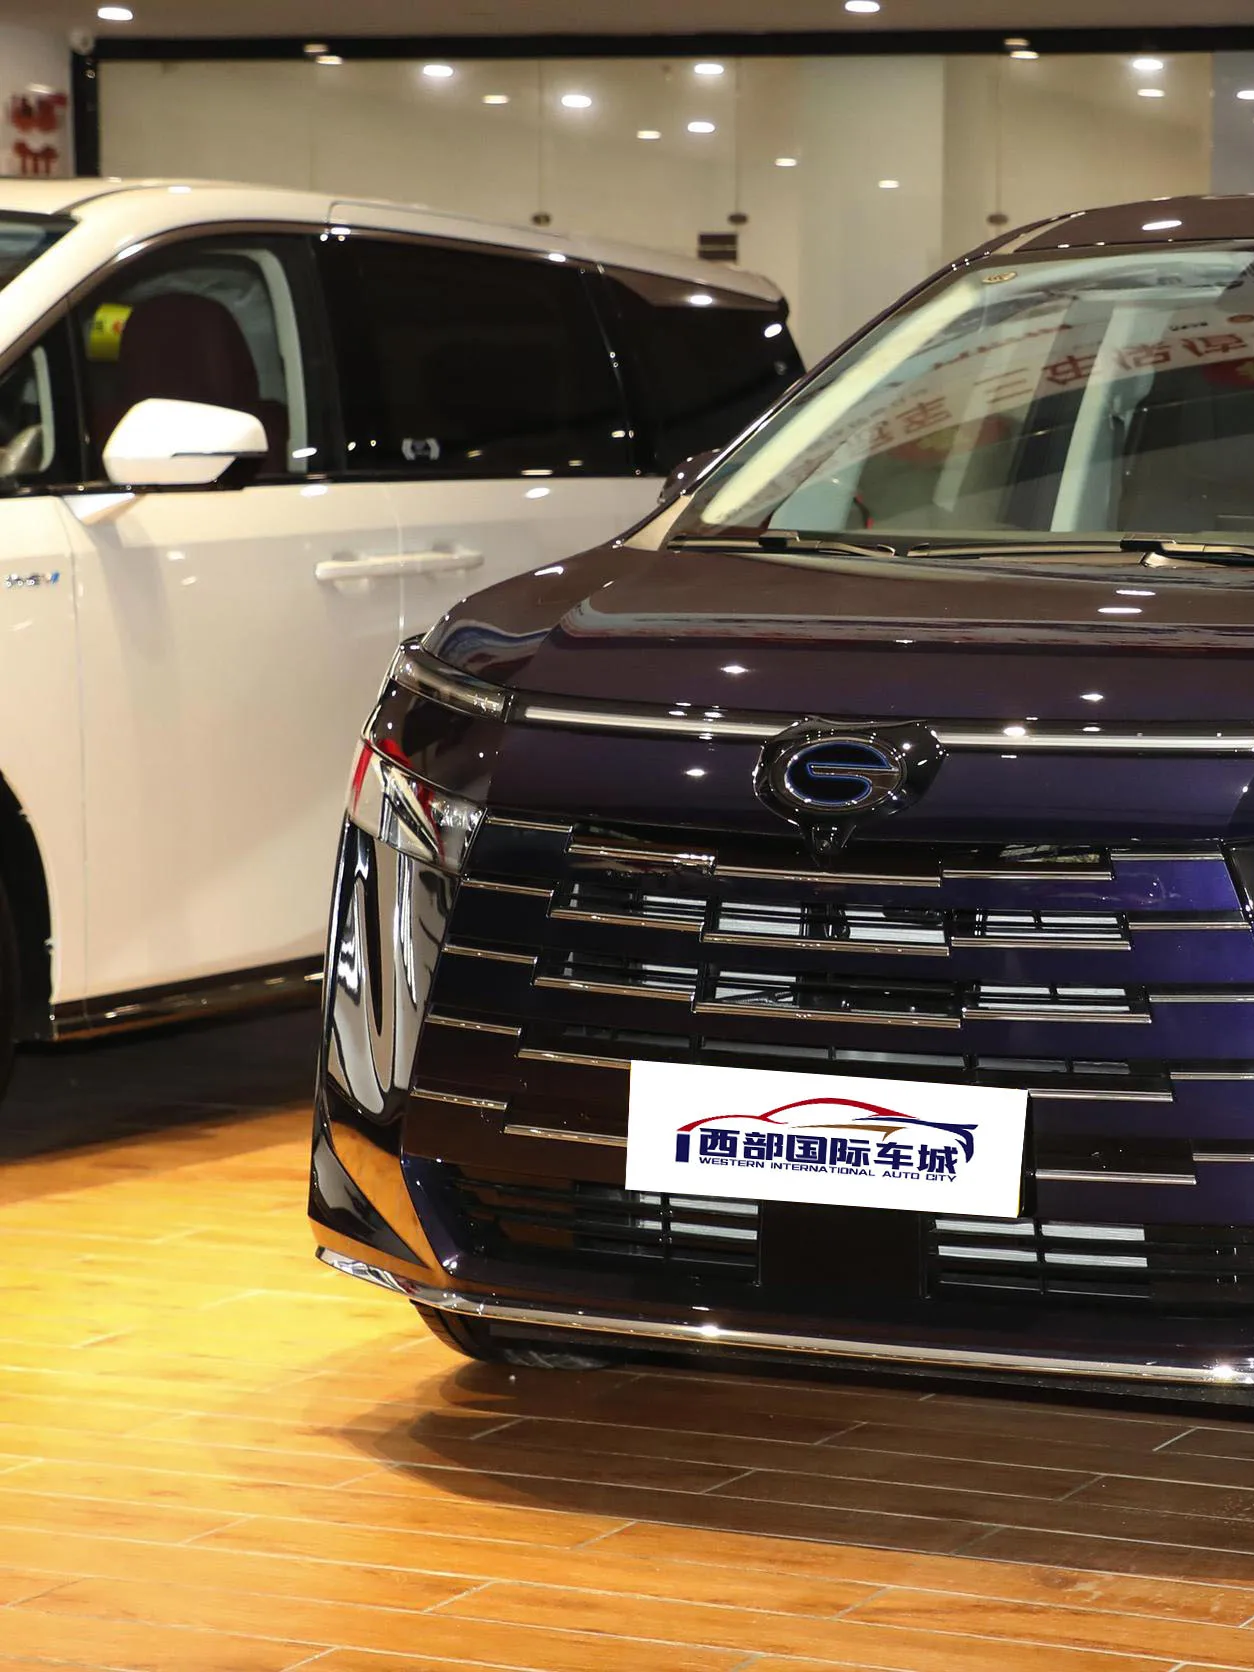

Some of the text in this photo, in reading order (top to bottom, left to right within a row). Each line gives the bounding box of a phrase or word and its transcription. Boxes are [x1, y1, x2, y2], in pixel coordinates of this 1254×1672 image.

[699, 1127, 958, 1175] 西部国际车城
[699, 1156, 957, 1183] WESTERN INTERNATIONAL AUTO CITY
